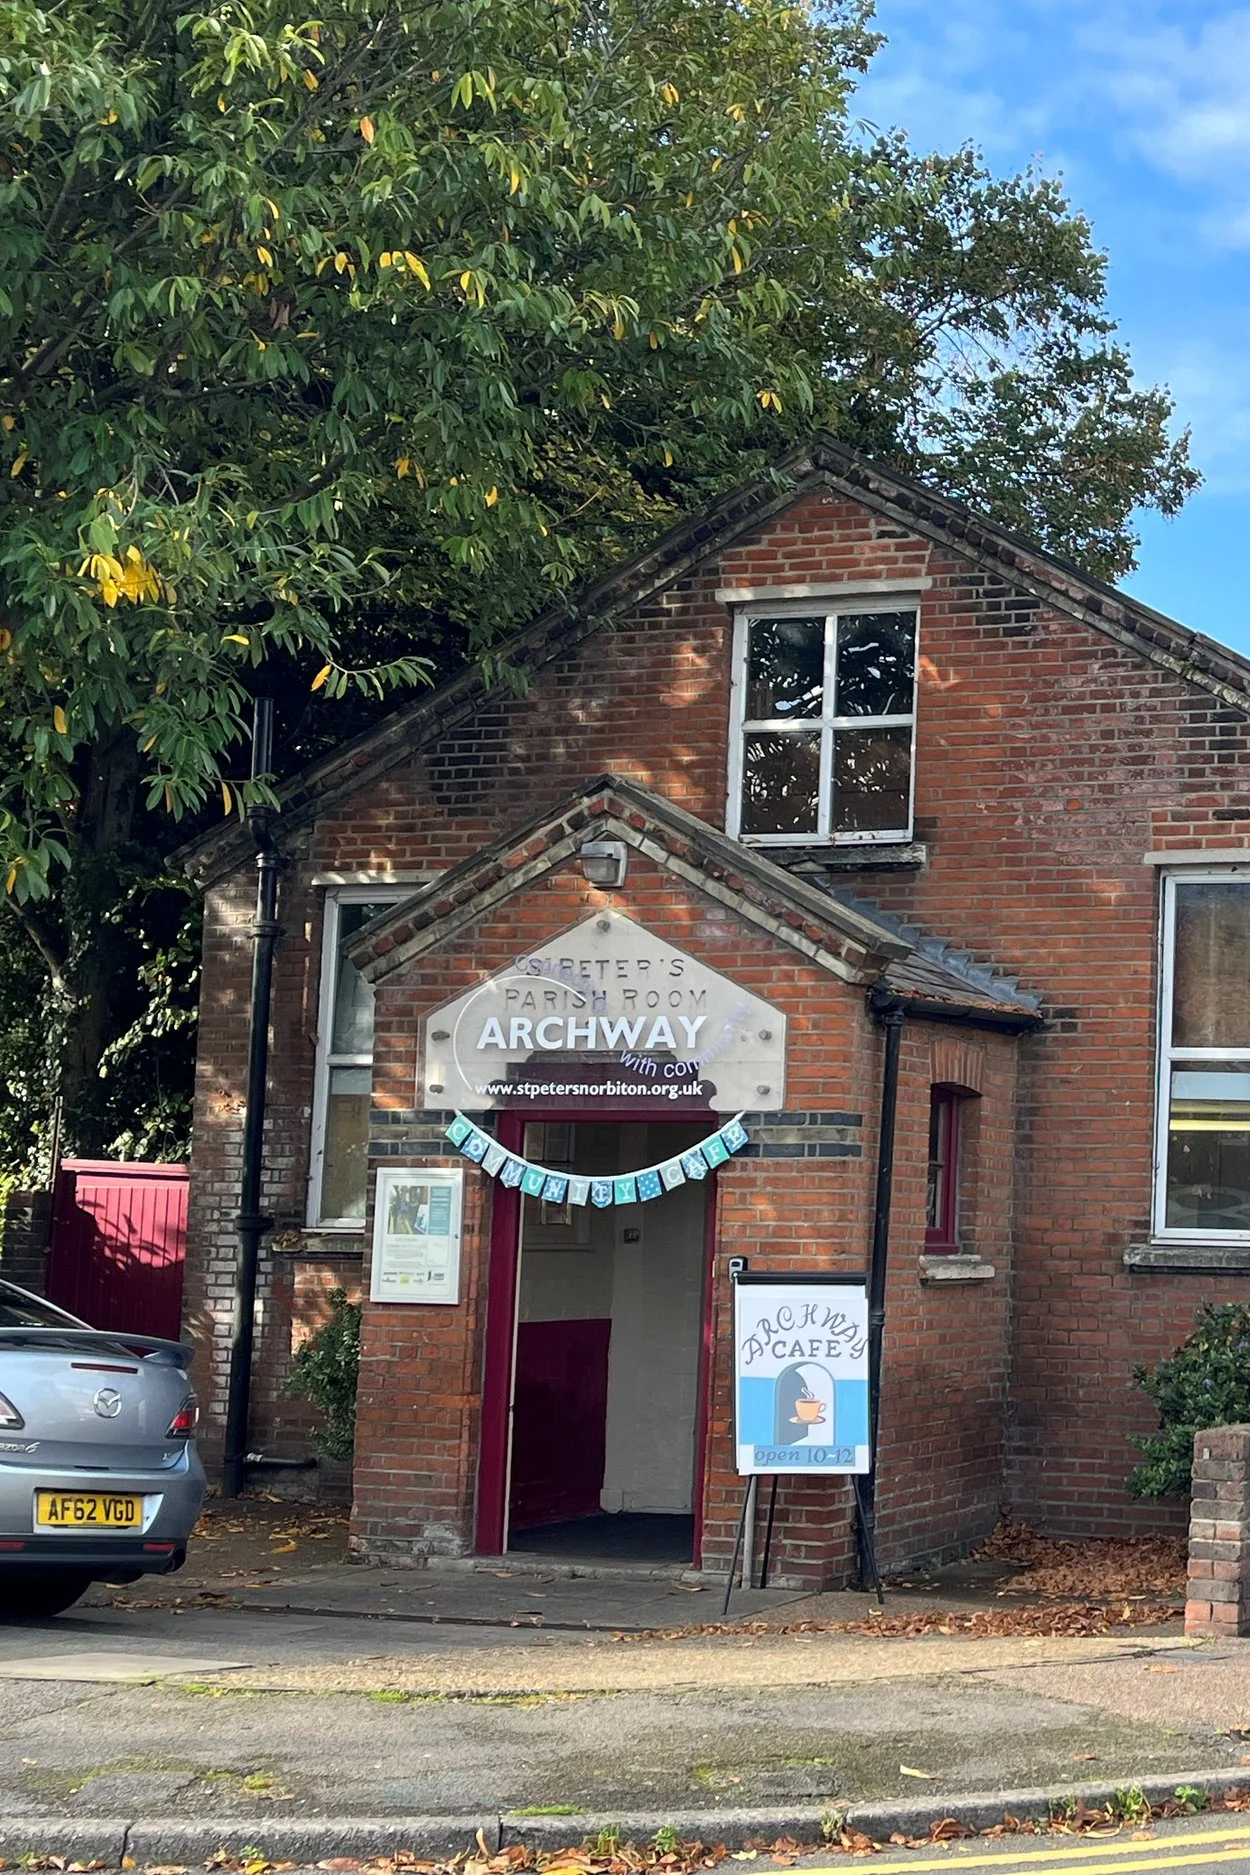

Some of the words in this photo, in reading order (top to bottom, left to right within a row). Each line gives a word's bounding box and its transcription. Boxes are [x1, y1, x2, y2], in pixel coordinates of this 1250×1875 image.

[559, 957, 685, 979] PETER'S
[504, 988, 607, 1011] PARISH
[622, 988, 707, 1011] ROOM
[475, 1015, 708, 1050] ARCHWAY
[619, 1050, 658, 1078] with
[475, 1079, 703, 1100] www.stpetersnorbiton.org.uk
[452, 1122, 632, 1204] COMMUNITY
[665, 1121, 746, 1184] CAFE
[742, 1303, 868, 1366] ARCHWAY
[771, 1339, 843, 1359] CAFE
[755, 1449, 800, 1467] open
[48, 1498, 97, 1521] AF62
[102, 1499, 135, 1522] VGD
